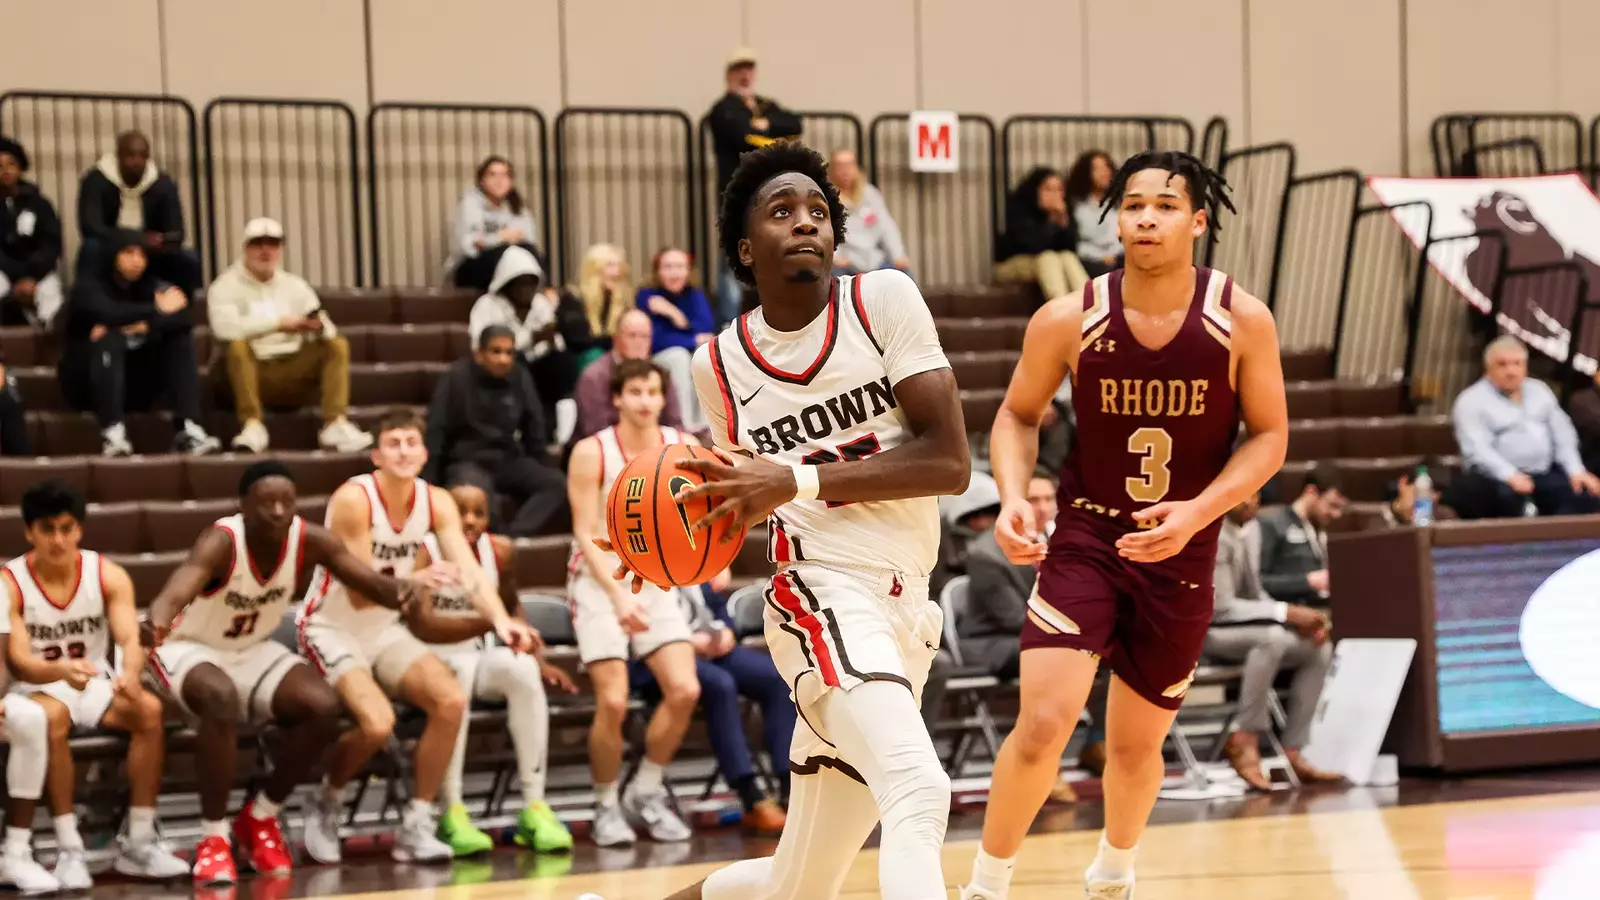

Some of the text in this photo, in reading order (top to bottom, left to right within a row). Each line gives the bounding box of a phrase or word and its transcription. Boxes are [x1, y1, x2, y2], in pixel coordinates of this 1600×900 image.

[918, 124, 950, 159] M
[747, 375, 898, 455] BROWN
[1099, 378, 1209, 417] RHODE
[1125, 427, 1173, 503] 3
[624, 476, 650, 555] ELITE
[224, 586, 286, 610] BROWN
[222, 610, 260, 639] 31
